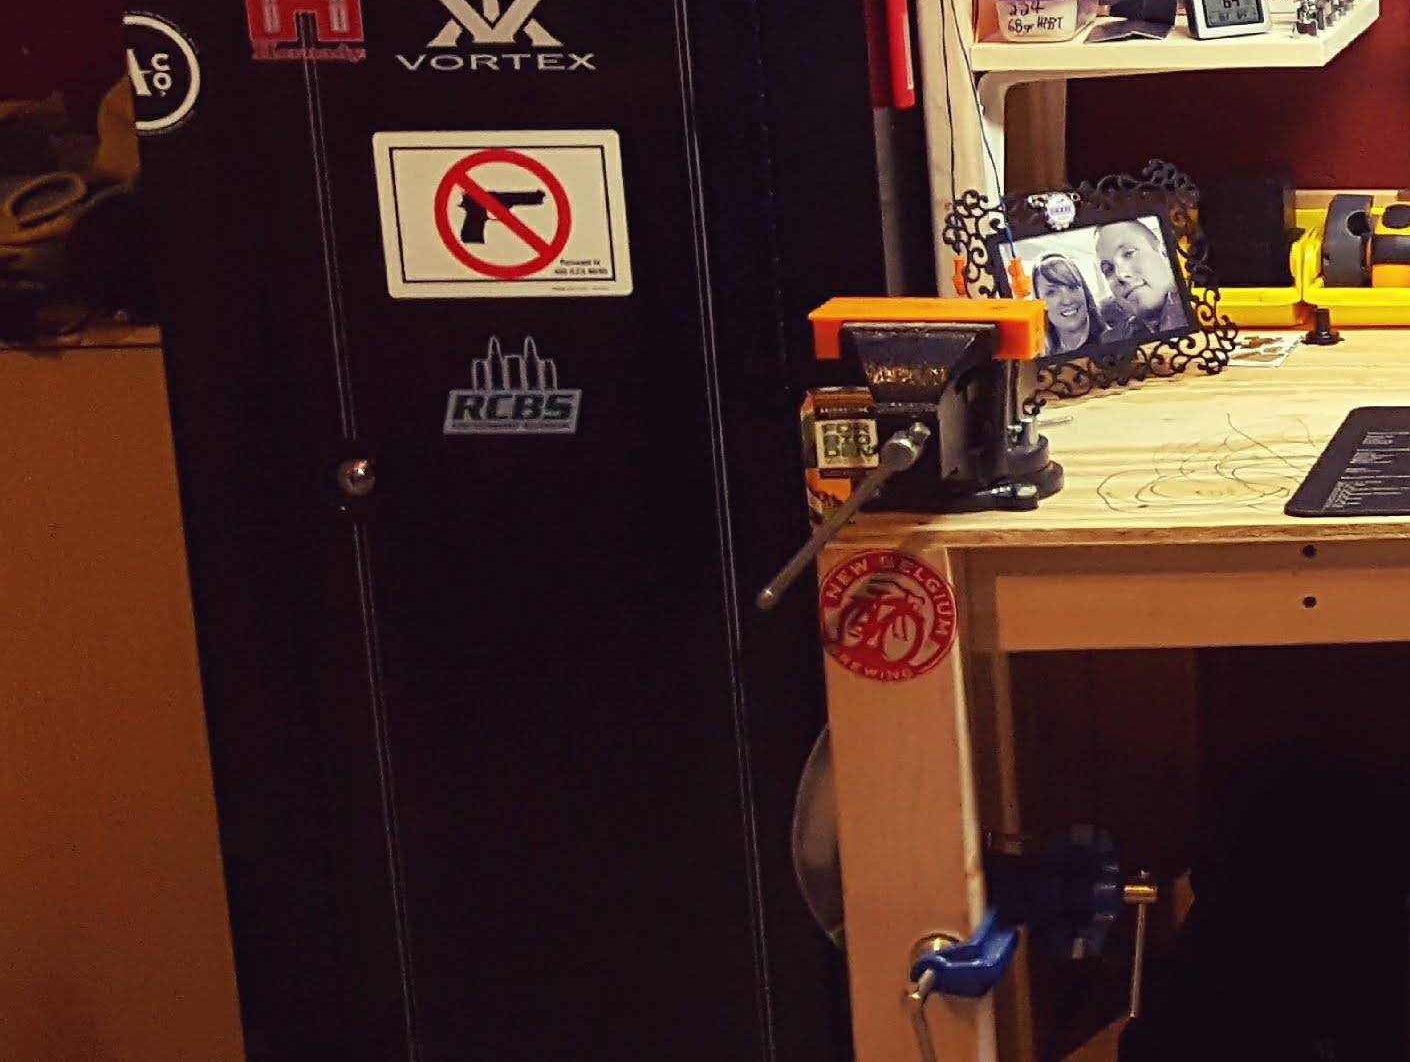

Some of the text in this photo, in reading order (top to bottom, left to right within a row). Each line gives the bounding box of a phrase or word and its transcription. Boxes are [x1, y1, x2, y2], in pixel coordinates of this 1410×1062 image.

[395, 53, 597, 71] VORTEX
[451, 395, 576, 420] RCBS
[825, 555, 953, 636] NEW BELGIUM
